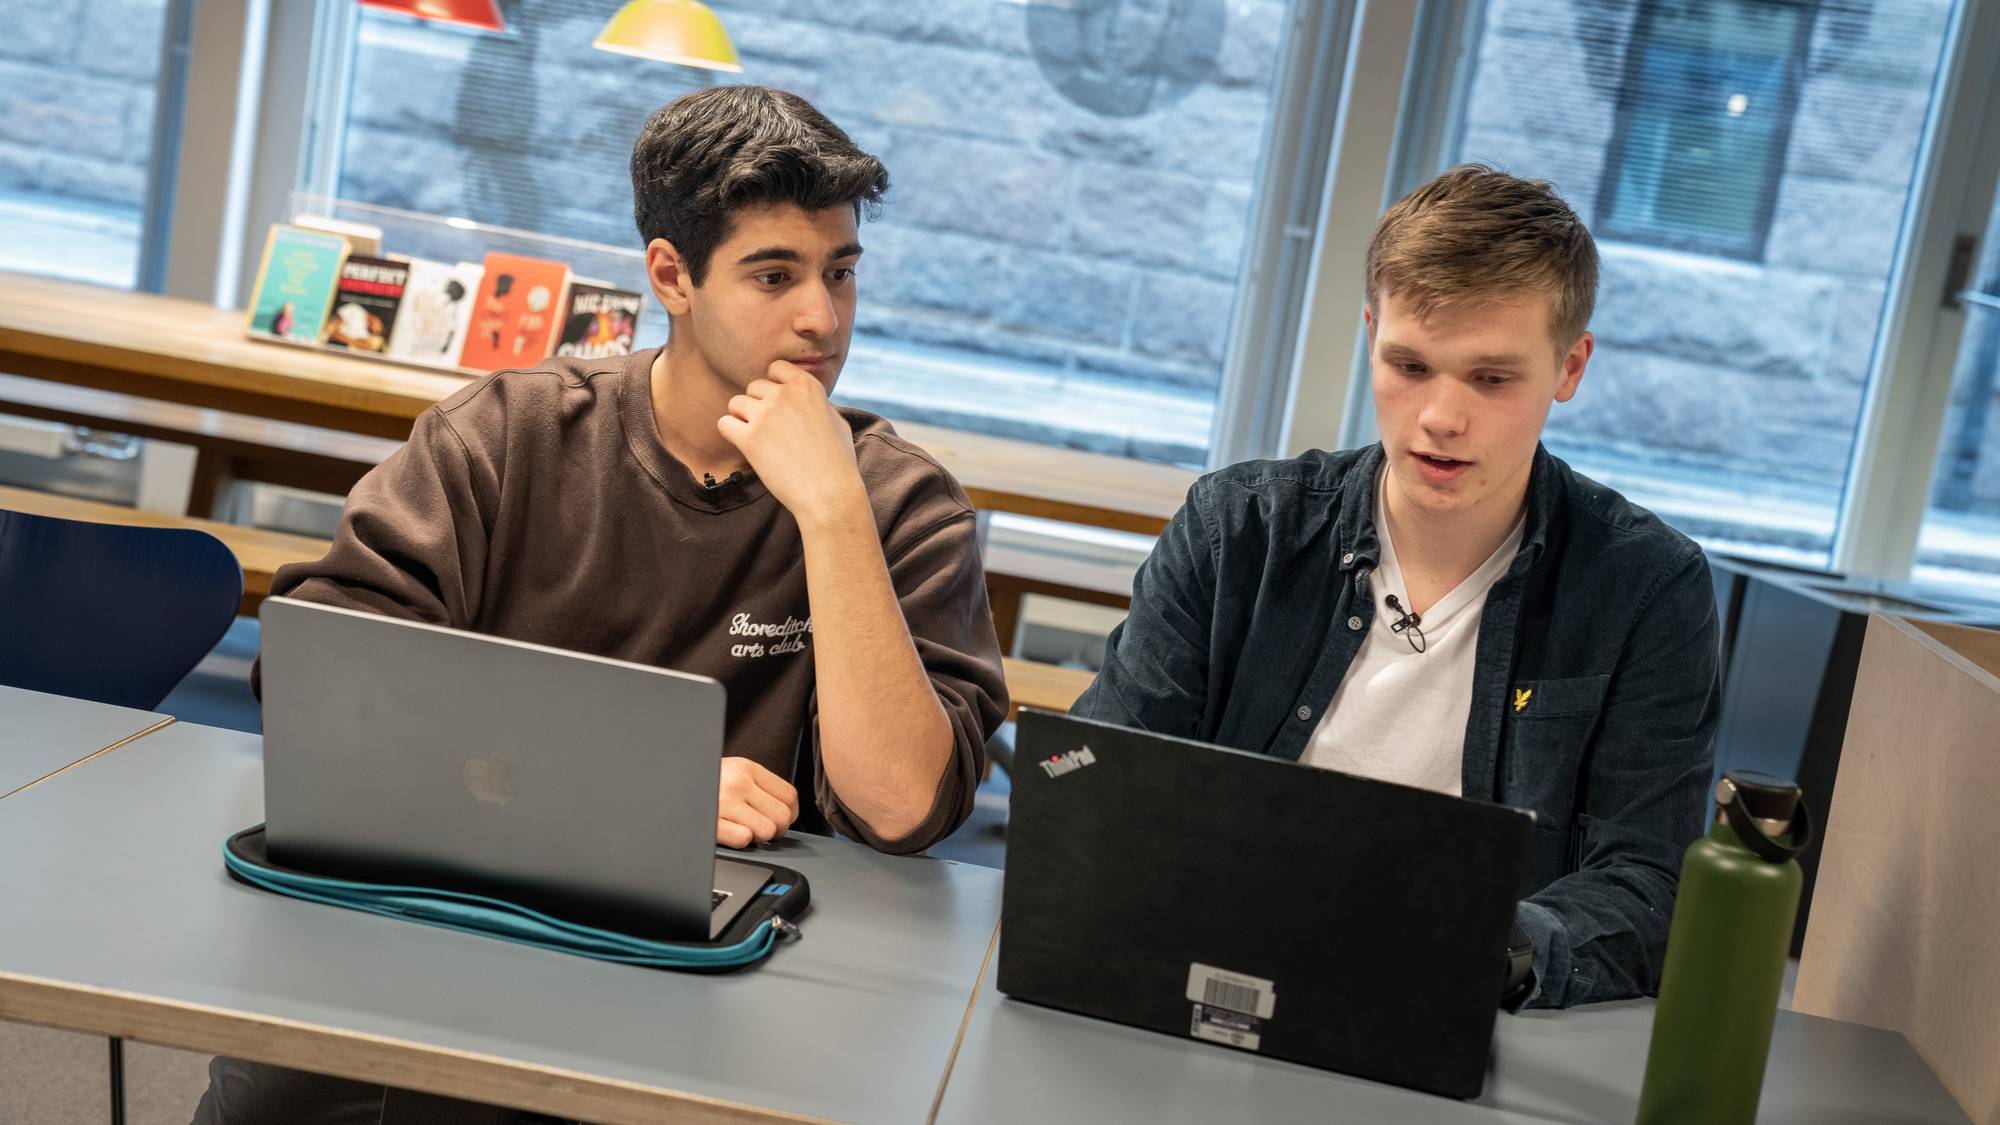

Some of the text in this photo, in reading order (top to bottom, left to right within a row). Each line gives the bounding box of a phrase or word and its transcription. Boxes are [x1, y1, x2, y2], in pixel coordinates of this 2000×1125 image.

[558, 335, 630, 360] CHAOS
[729, 613, 813, 637] Shoreditch
[731, 634, 806, 658] arts club
[1039, 745, 1096, 778] ThinkPad
